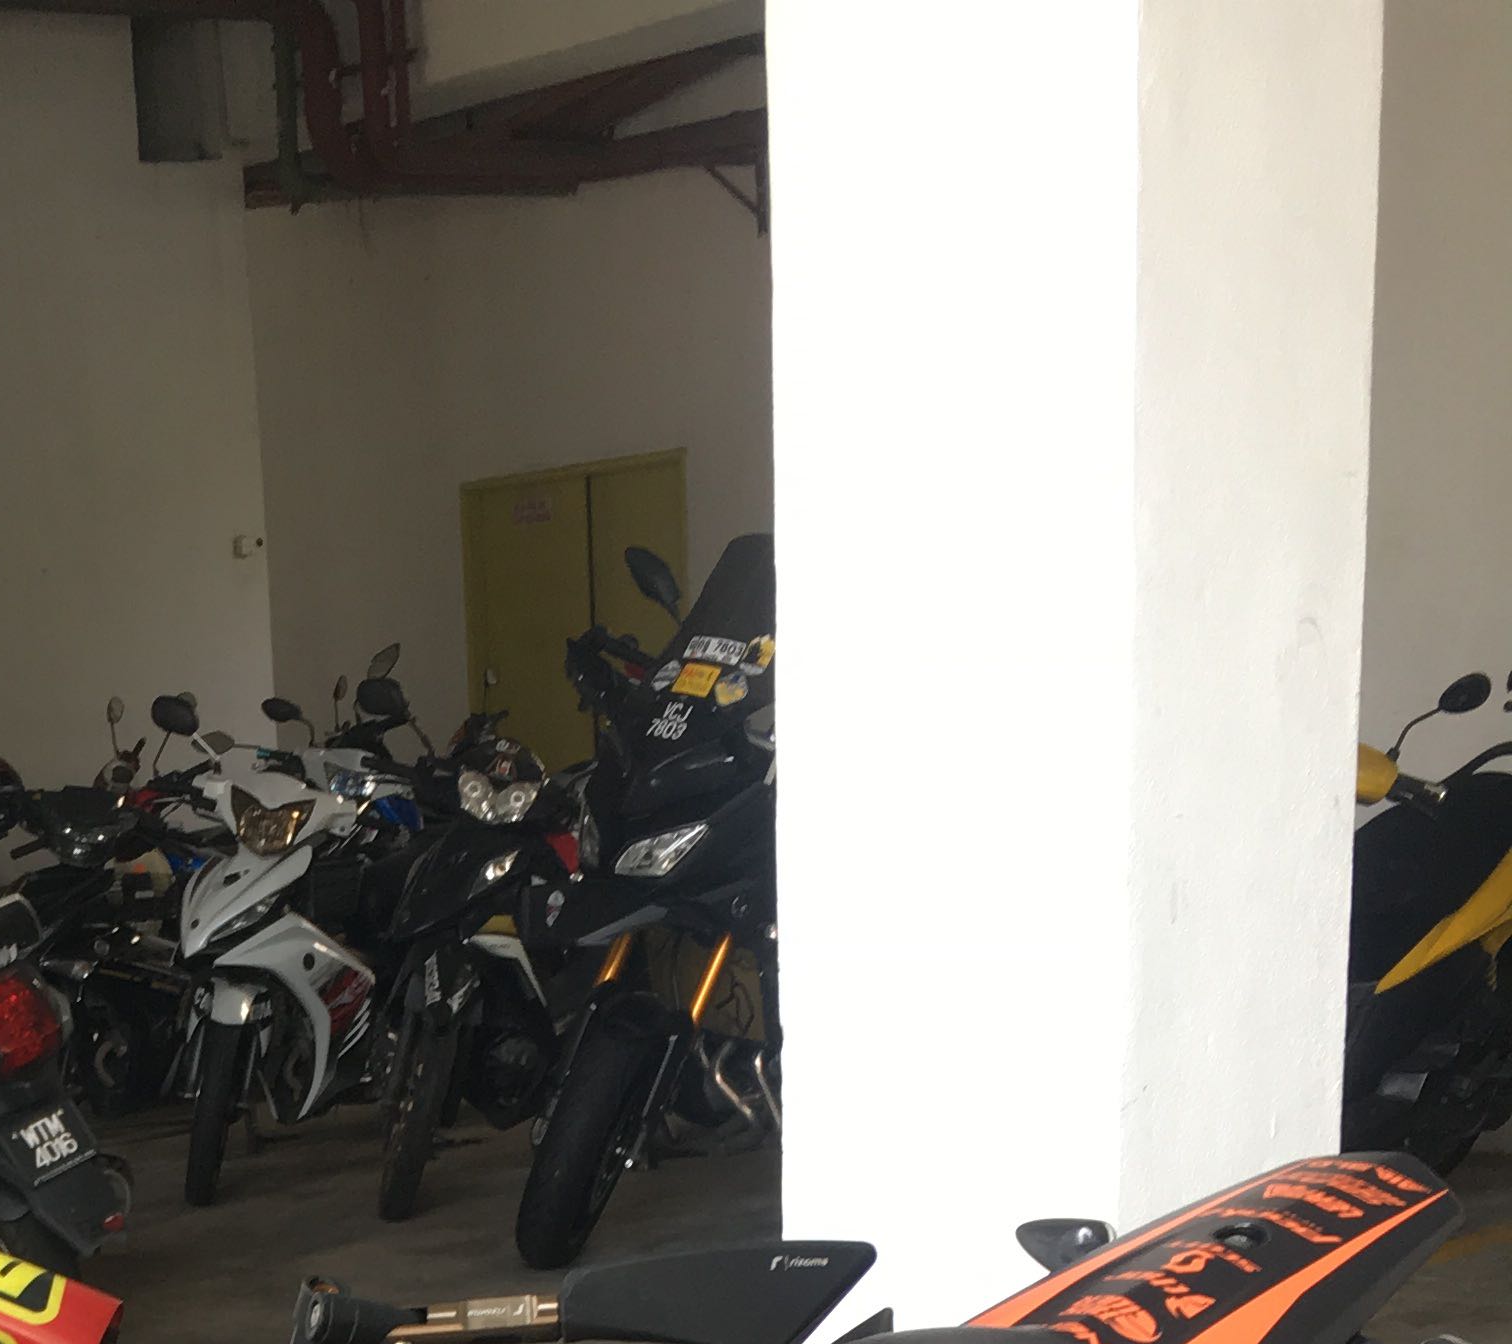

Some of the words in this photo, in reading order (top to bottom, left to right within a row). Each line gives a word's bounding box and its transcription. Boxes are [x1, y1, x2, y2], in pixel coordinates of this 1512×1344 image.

[663, 702, 694, 722] VCJ
[19, 1113, 65, 1149] WTM
[36, 1132, 78, 1168] 4016
